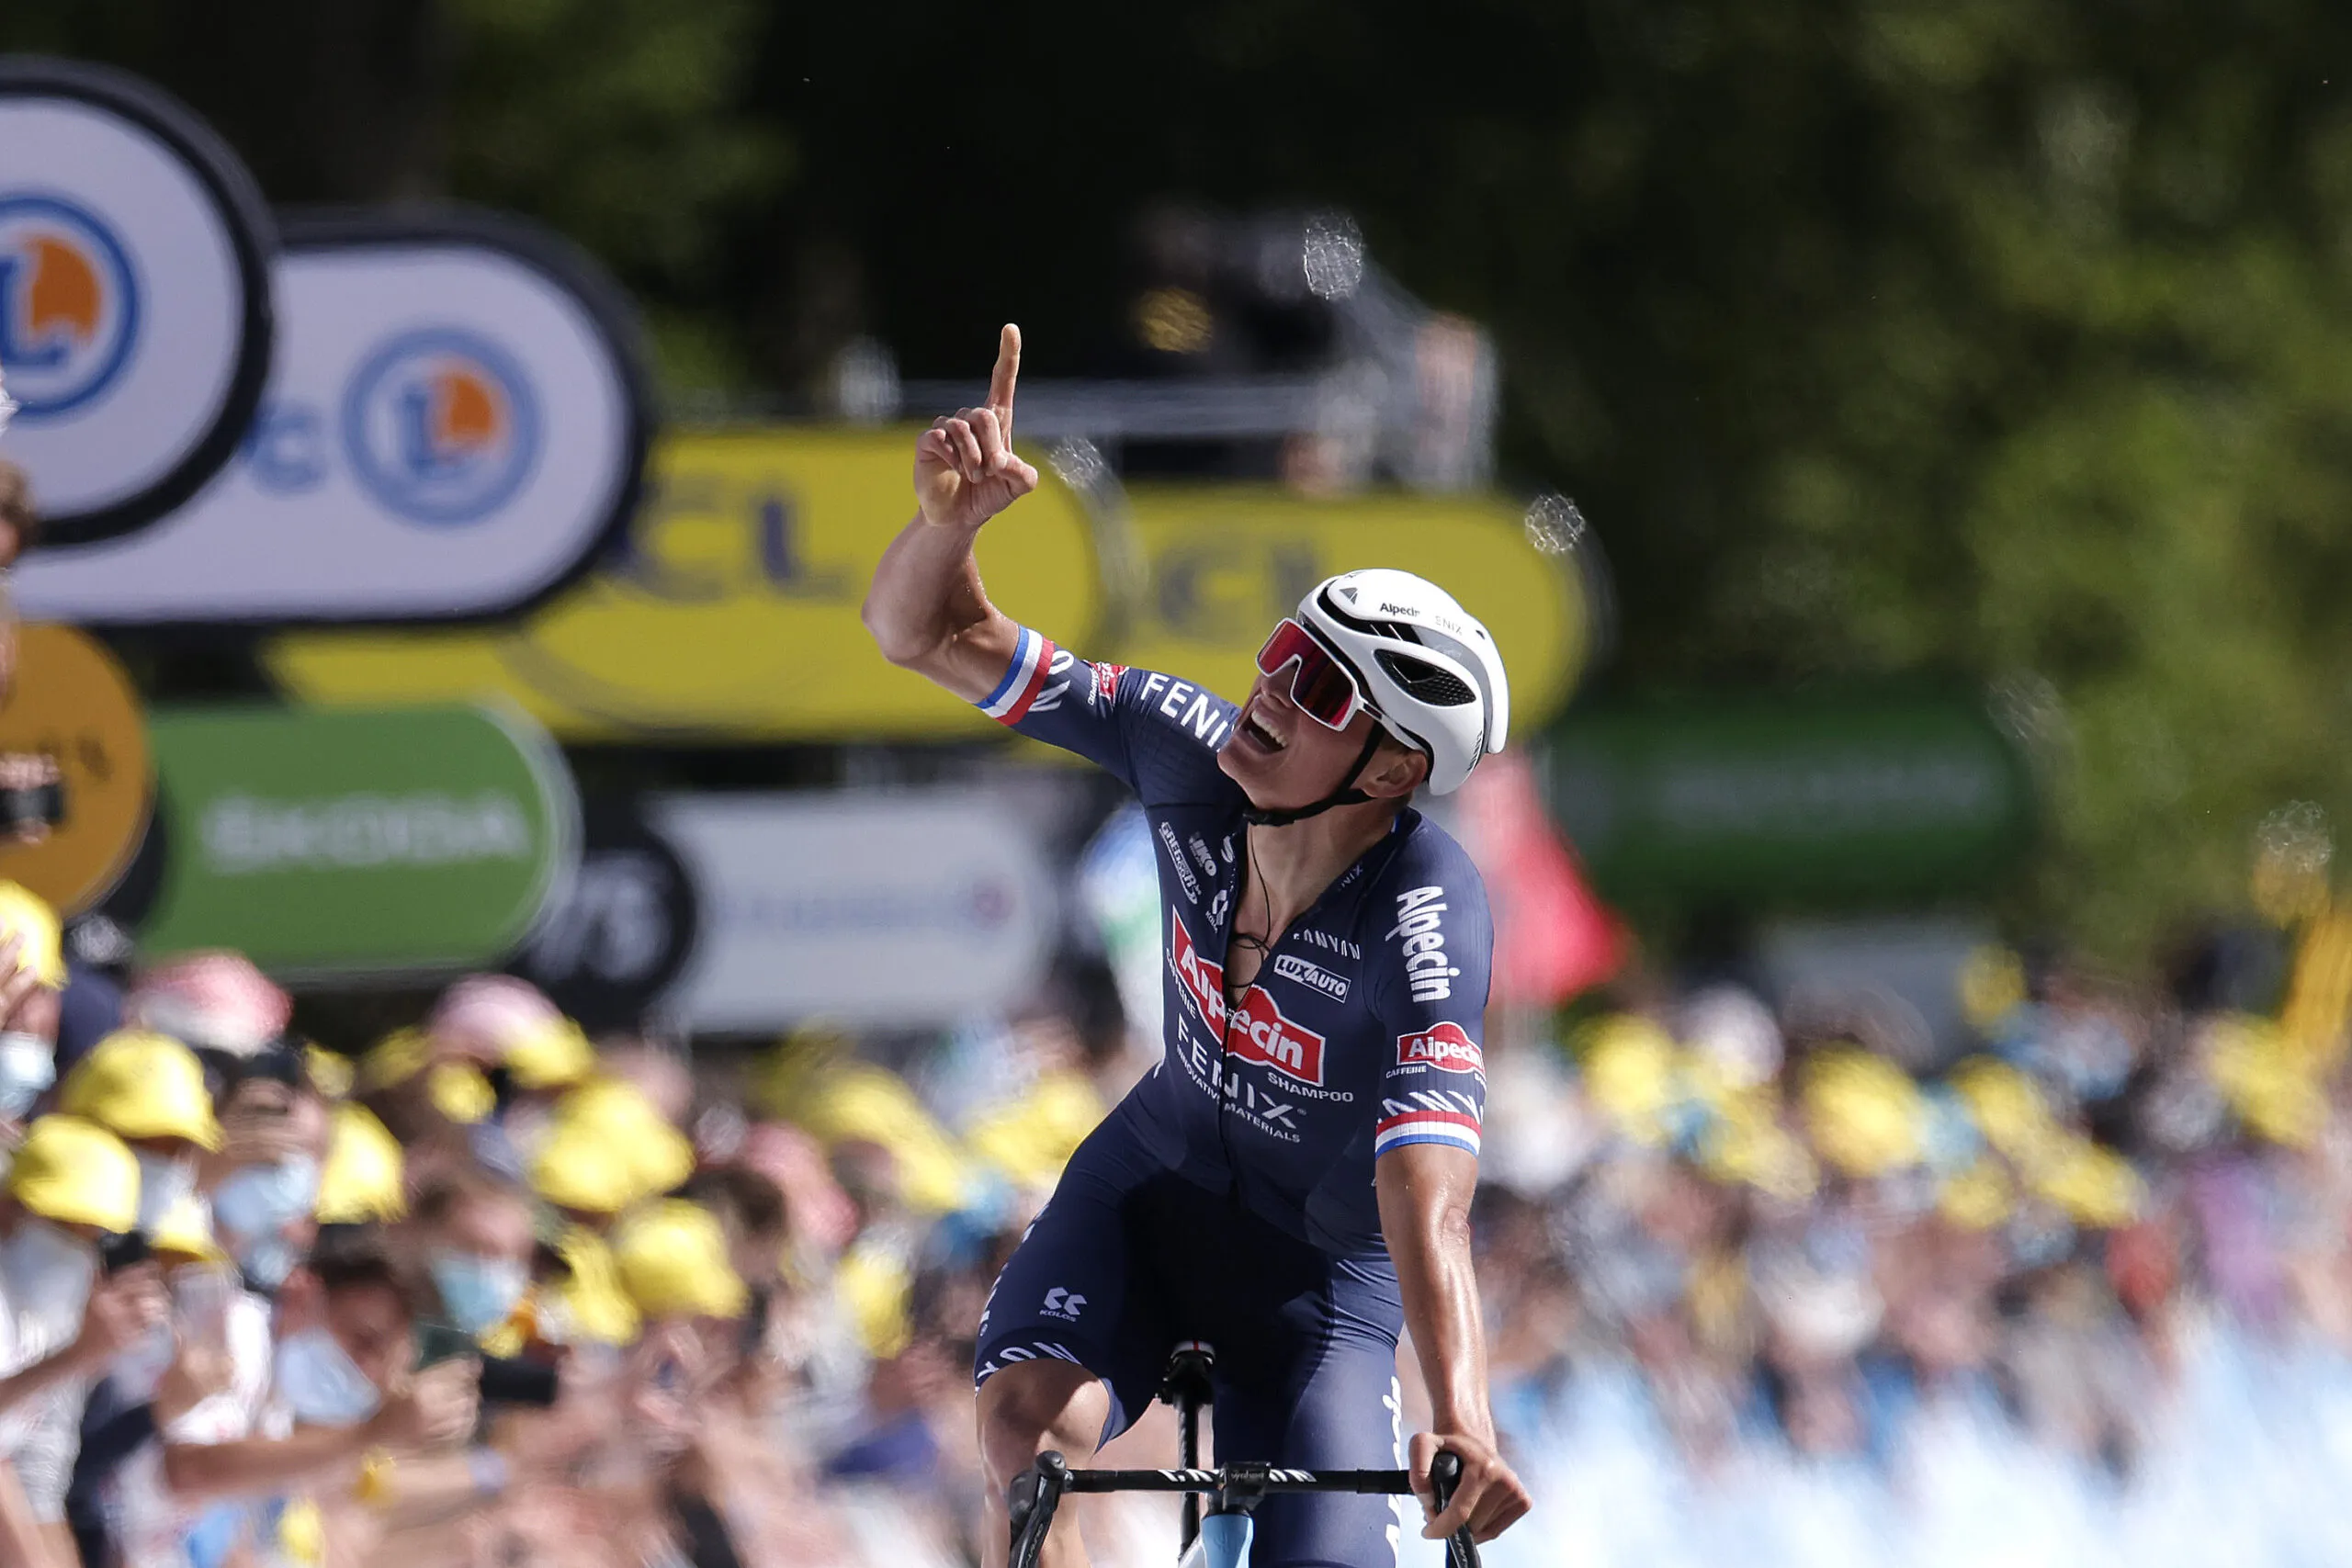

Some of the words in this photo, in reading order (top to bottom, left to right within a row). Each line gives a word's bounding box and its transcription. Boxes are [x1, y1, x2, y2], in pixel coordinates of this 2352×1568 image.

[1140, 672, 1237, 753] FENI
[1385, 886, 1461, 1002] Alpecin
[1181, 943, 1304, 1070] Alpecin
[1176, 1043, 1221, 1103] INNOVATIV
[1224, 1101, 1301, 1143] MATERIALS
[1267, 1071, 1354, 1103] SHAMPOO
[1385, 1065, 1427, 1078] CAFFEINE
[1408, 1037, 1484, 1069] Alpecin
